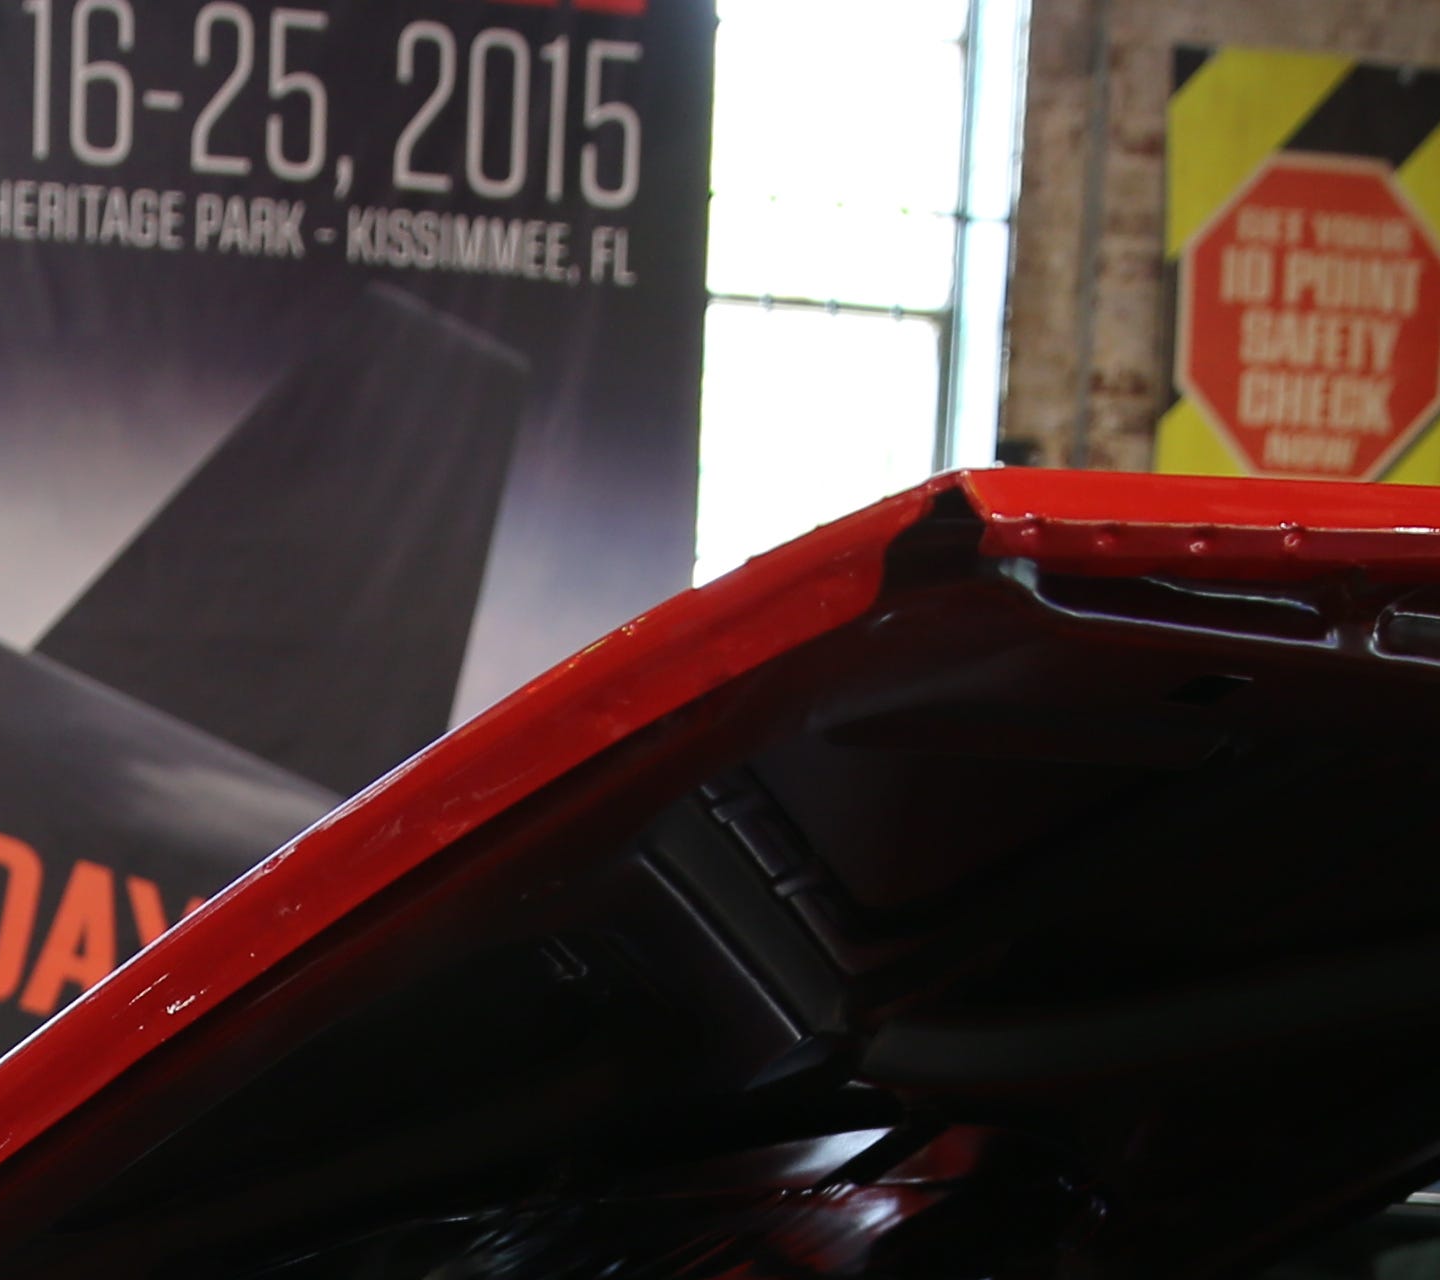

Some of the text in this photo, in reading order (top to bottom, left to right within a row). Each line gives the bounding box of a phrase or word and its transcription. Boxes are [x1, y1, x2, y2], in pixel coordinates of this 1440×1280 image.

[23, 0, 353, 196] 16-25,
[392, 20, 643, 207] 2015
[195, 200, 305, 257] PARK
[347, 208, 580, 284] KISSIMMEE,
[592, 228, 637, 285] FL
[1237, 206, 1411, 250] GET YOUR
[1221, 246, 1420, 316] 10 POINT
[1240, 308, 1400, 373] SAFETY
[1238, 369, 1394, 435] CHECK
[1265, 430, 1358, 472] NOW
